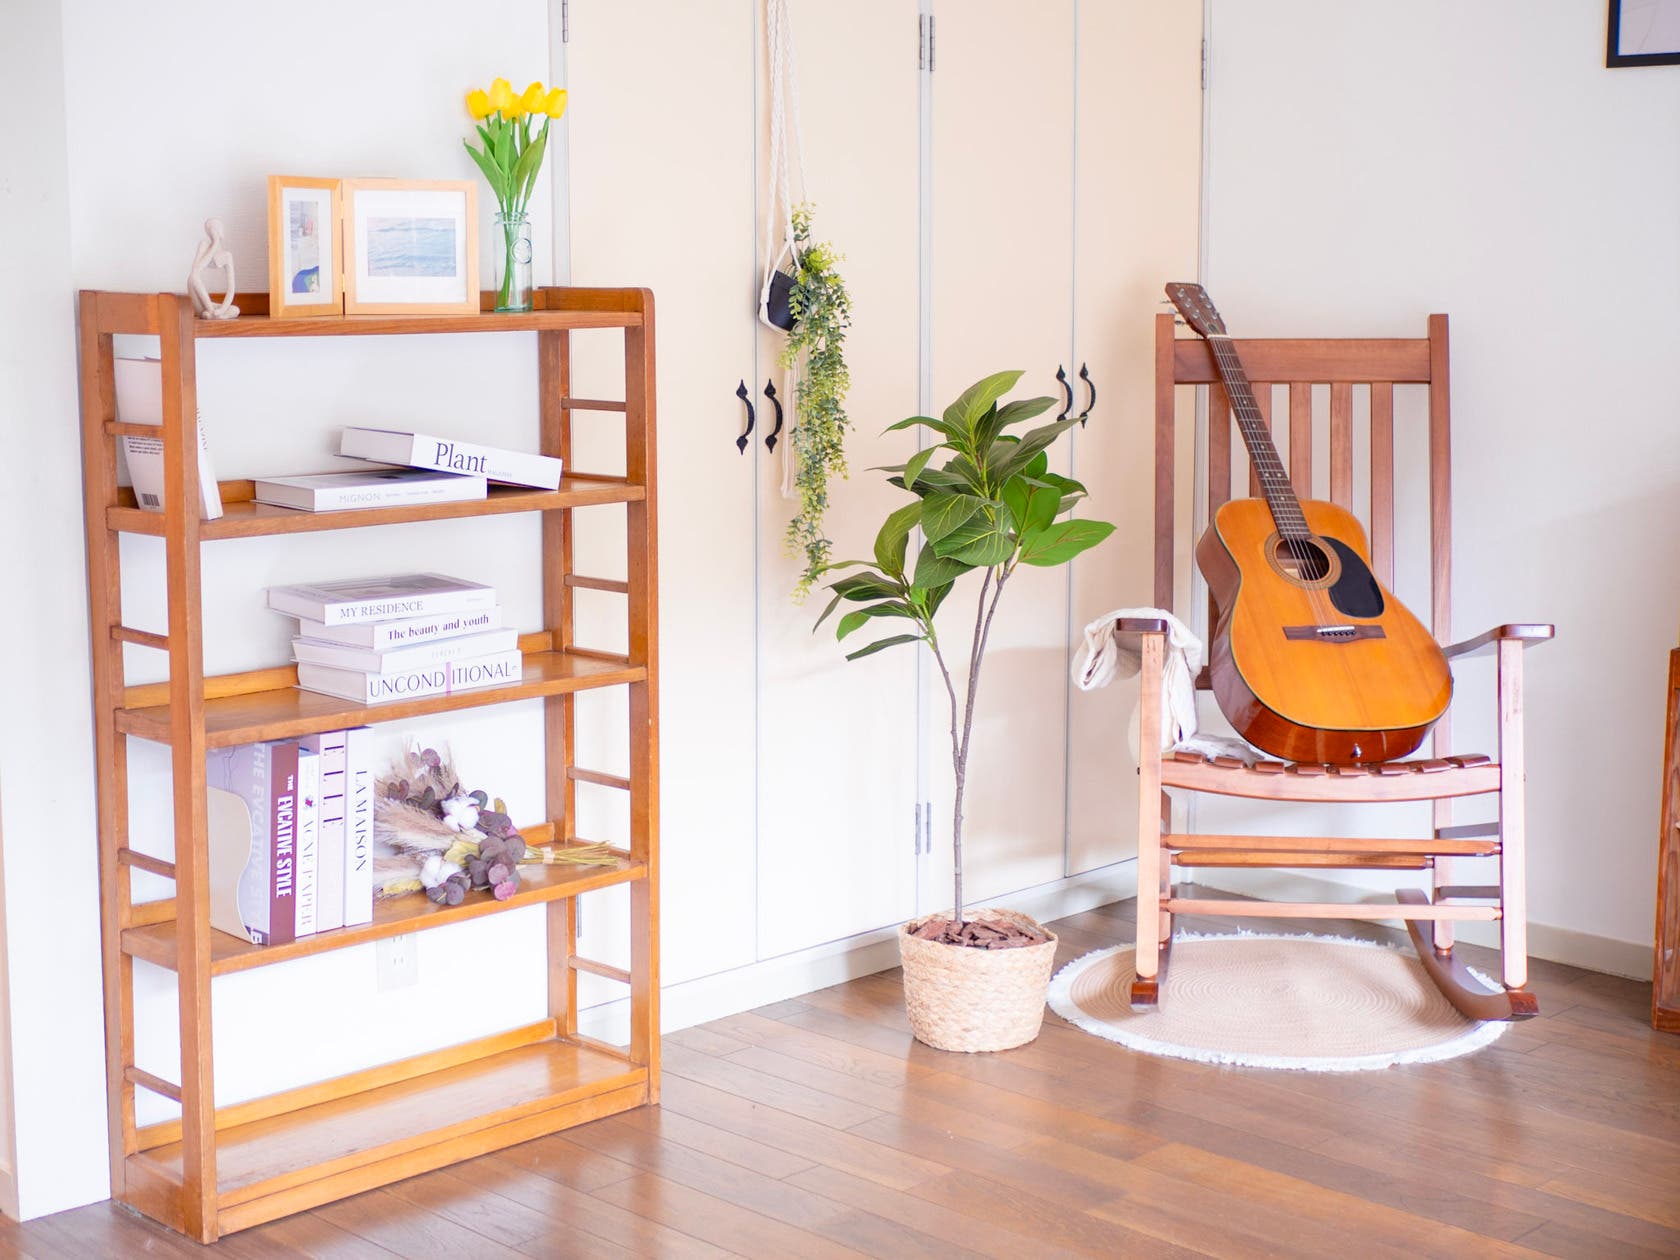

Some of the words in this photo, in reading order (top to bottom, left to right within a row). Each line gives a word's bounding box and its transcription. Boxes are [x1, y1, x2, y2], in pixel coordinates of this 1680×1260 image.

[434, 441, 487, 474] Plant
[339, 492, 381, 504] MIGNON
[340, 607, 357, 618] MY
[361, 600, 424, 616] RESIDENCE
[388, 630, 406, 641] The
[408, 623, 440, 639] beauty
[442, 617, 460, 632] and
[463, 613, 489, 629] youth
[369, 661, 512, 698] UNCONDITIONAL
[355, 771, 368, 794] LA
[355, 800, 368, 872] MAISON
[275, 858, 293, 898] STYLE
